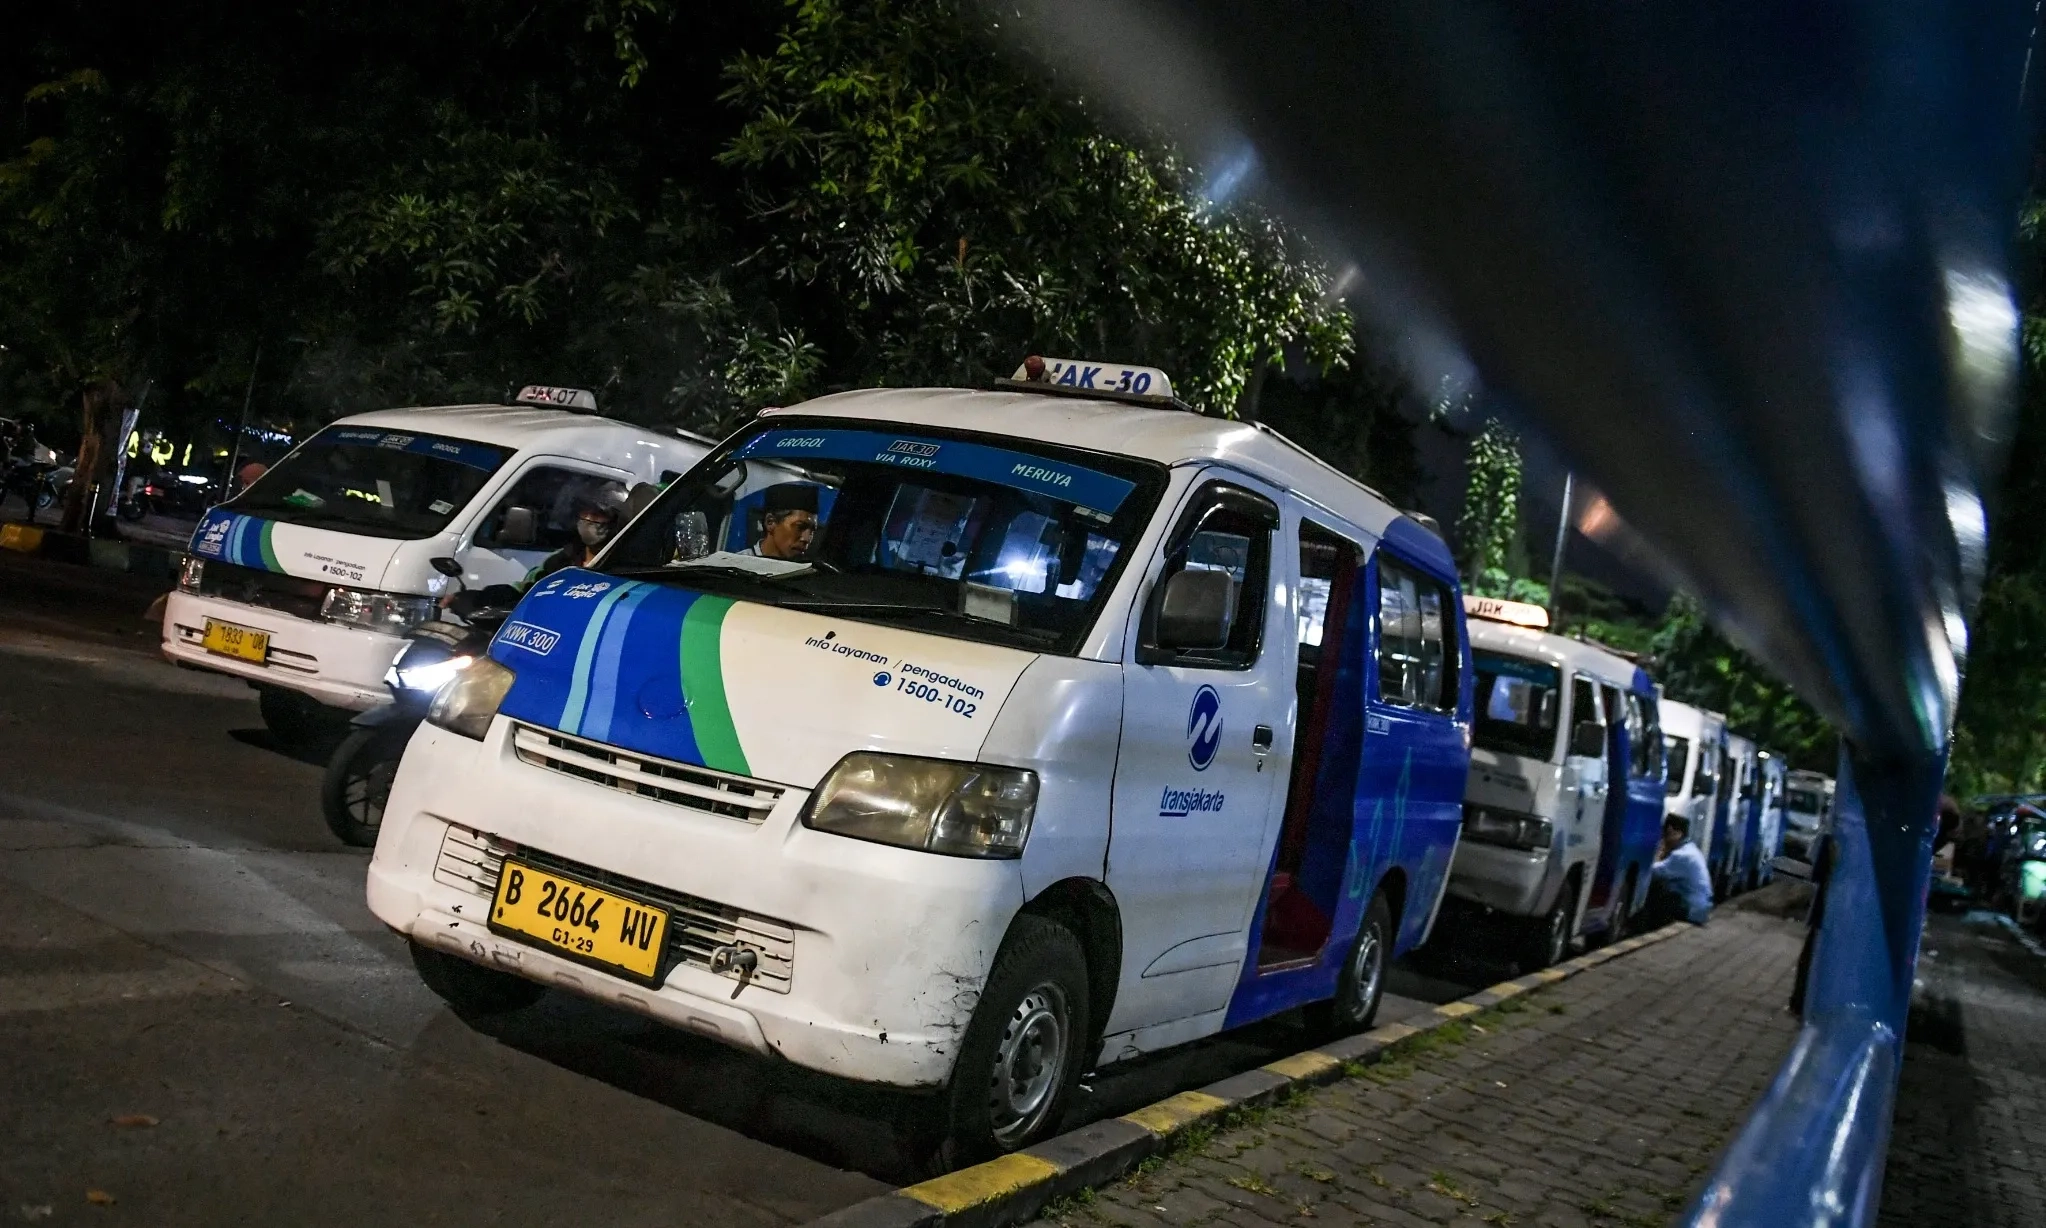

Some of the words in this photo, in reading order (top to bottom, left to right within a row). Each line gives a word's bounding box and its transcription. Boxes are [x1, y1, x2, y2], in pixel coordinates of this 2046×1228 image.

[776, 438, 826, 448] GROGOL
[875, 453, 896, 463] VIA
[900, 456, 937, 468] ROXY
[1011, 463, 1072, 488] MERUYA
[330, 566, 363, 581] 1500-102
[204, 622, 213, 638] B
[504, 624, 532, 643] KWK
[528, 631, 555, 650] 300
[805, 637, 830, 650] Info
[832, 643, 888, 665] Layanan
[901, 663, 985, 700] pengaduan
[897, 677, 977, 718] 1500-102
[1159, 785, 1225, 817] transjakarta
[505, 869, 525, 905] B
[537, 880, 605, 933] 2664
[620, 907, 658, 950] WV
